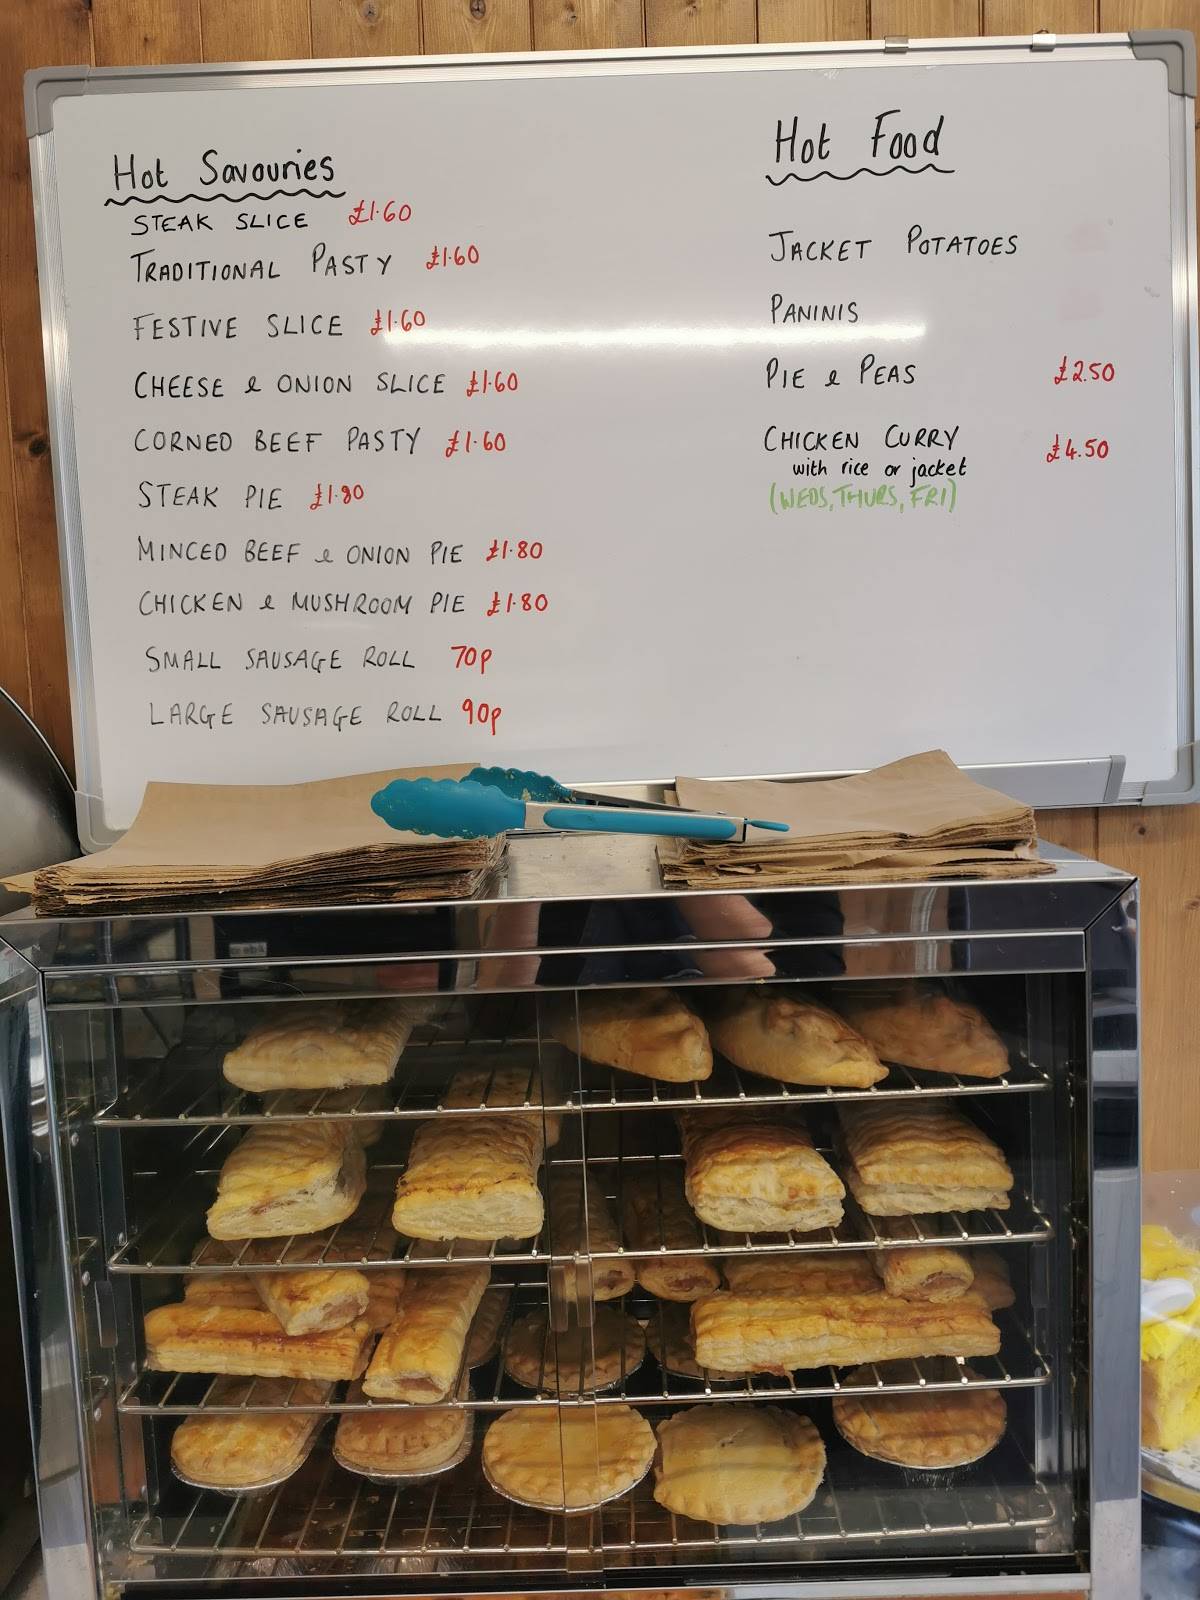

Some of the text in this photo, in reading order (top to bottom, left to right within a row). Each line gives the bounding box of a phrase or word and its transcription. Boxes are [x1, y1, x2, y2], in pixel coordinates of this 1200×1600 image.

[776, 109, 944, 164] Hot Food
[114, 149, 334, 191] Hot Savouries
[131, 213, 213, 235] STEAK
[236, 213, 308, 230] SLICE
[769, 224, 1018, 262] JACKET POTATOES
[130, 249, 280, 283] TRADITIONAL
[312, 242, 392, 276] PASTY
[771, 293, 858, 324] PANINIS
[133, 313, 237, 340] FESTIVE
[267, 314, 343, 338] SLICE
[135, 371, 224, 399] CHEESE
[277, 374, 351, 394] ONION
[377, 372, 446, 394] SLICE
[766, 357, 805, 389] PIE
[860, 354, 916, 385] PEAS
[1054, 355, 1115, 385] £2.50
[135, 429, 232, 452] CORNED
[255, 429, 322, 453] BEEF
[348, 426, 421, 455] PASTY
[764, 424, 1109, 464] CHICKEN CURRY £4.50
[793, 456, 967, 488] with rice or jacket
[139, 481, 218, 508] STEAK
[245, 485, 282, 510] PIE
[138, 536, 226, 562] MINCED
[245, 539, 301, 563] BEEF
[347, 545, 410, 565] ONION
[431, 541, 463, 565] PIE
[139, 591, 242, 616] CHICKEN
[292, 592, 412, 615] MUSHROOM
[430, 592, 464, 614] PIE
[146, 645, 492, 675] SMALL SAUSAGE ROLL 70p
[149, 699, 502, 736] LARGE SAUSAGE ROLL 90p
